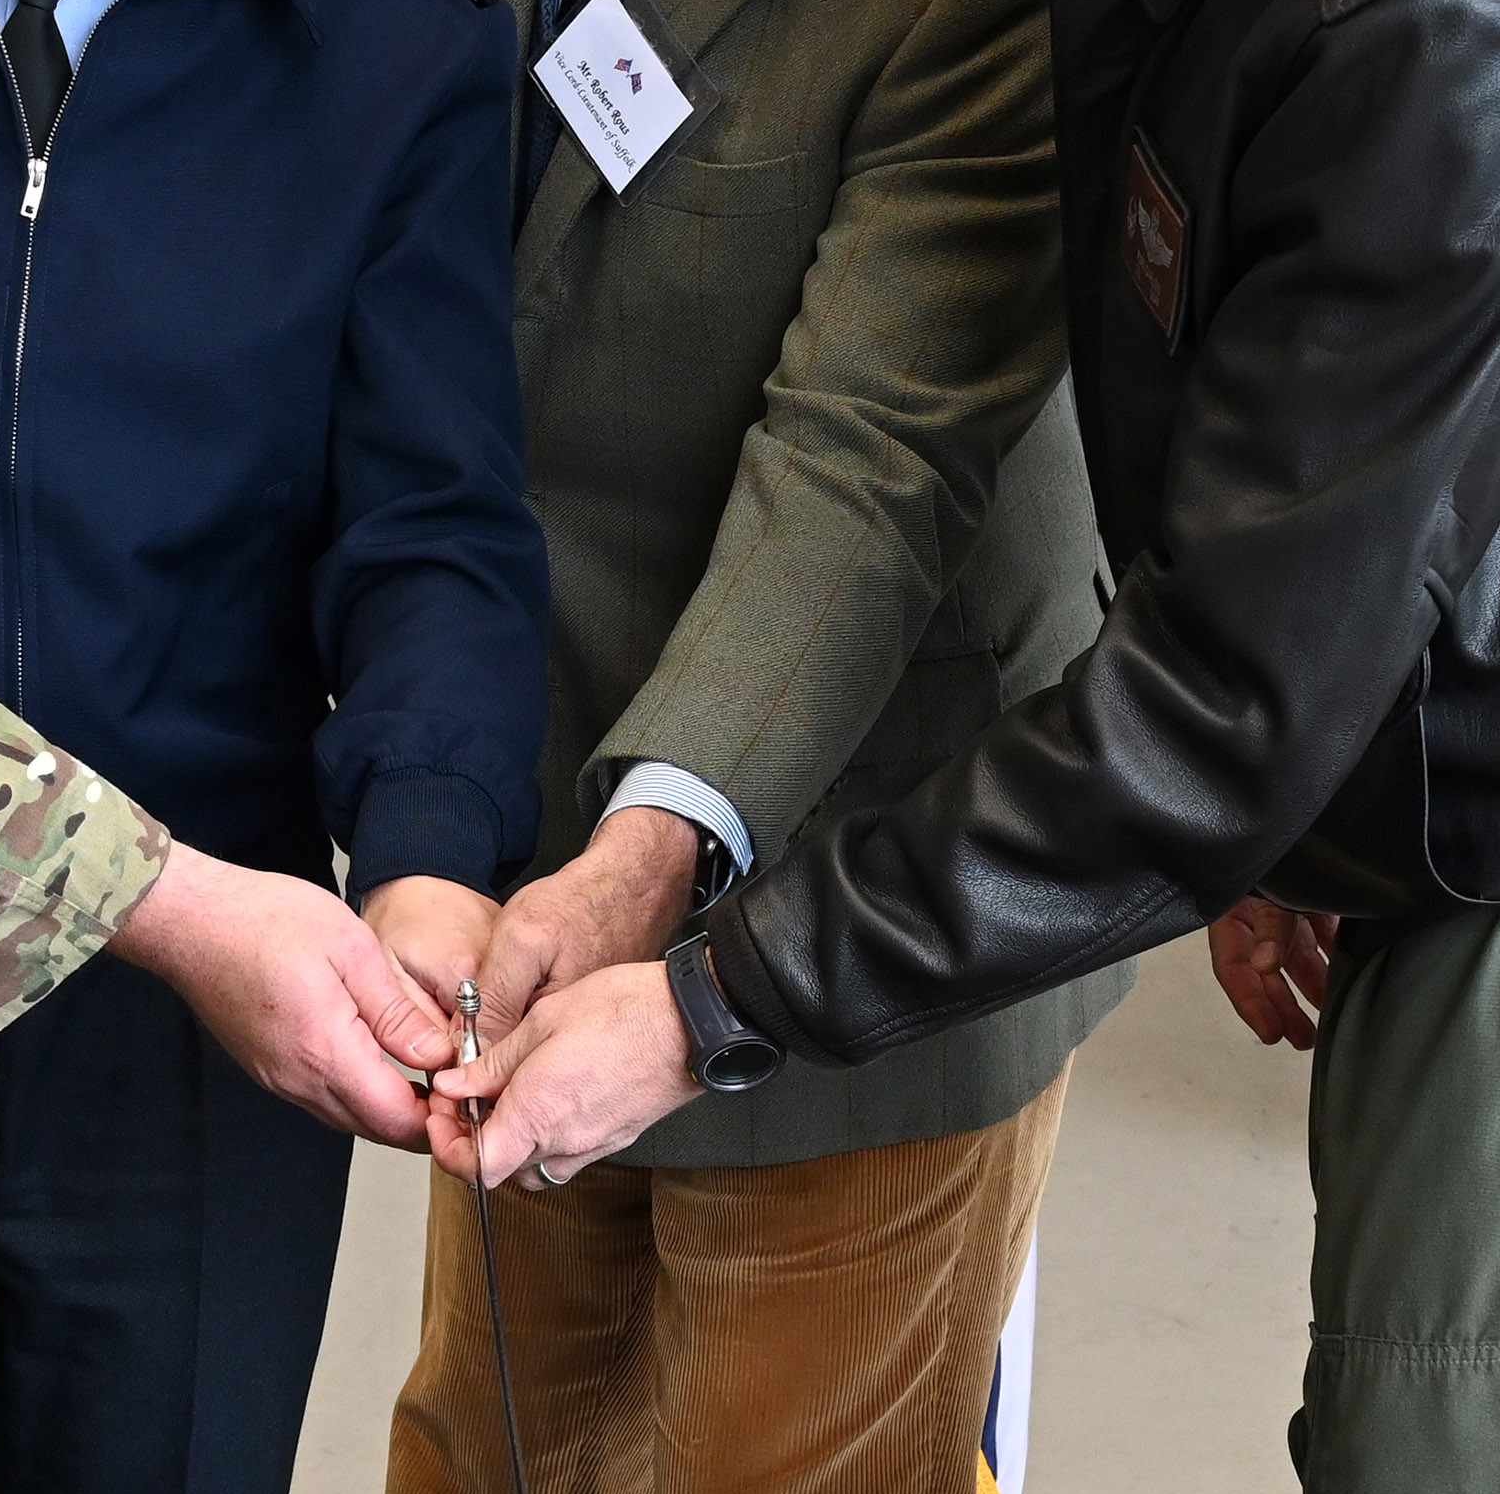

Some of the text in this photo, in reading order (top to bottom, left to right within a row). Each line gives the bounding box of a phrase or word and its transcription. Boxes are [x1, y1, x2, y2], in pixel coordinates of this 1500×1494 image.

[554, 51, 567, 69] Vice
[604, 130, 618, 141] of
[611, 139, 637, 173] Suffolk
[577, 60, 631, 135] Mr. Robert Rous
